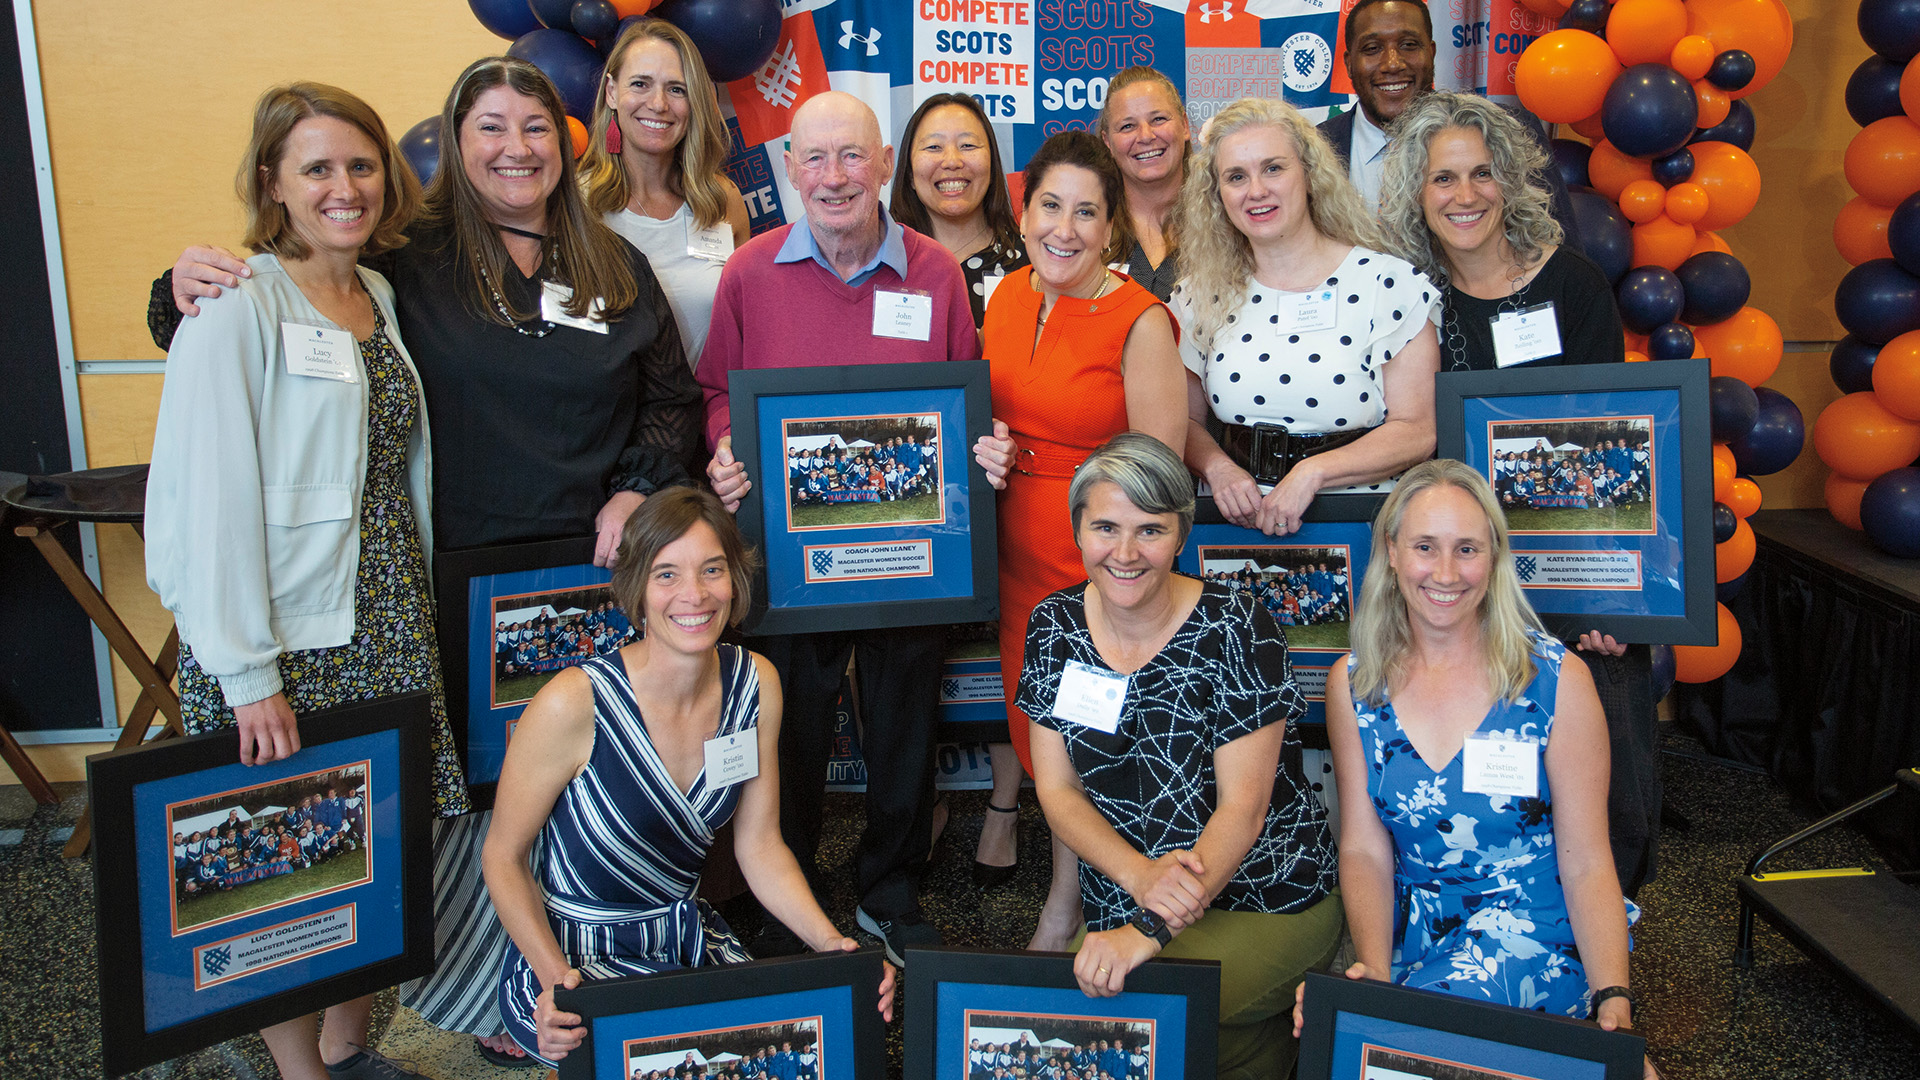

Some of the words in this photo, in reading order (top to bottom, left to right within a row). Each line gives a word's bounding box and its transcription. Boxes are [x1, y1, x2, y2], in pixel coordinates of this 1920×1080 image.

[920, 0, 1029, 25] COMPETE
[1038, 0, 1154, 31] SCOTS
[936, 30, 1012, 55] SCOTS
[1040, 34, 1155, 71] SCOTS
[1188, 54, 1280, 74] COMPETE
[1314, 38, 1330, 75] COLLEGE
[920, 60, 1028, 86] COMPETE
[1042, 77, 1110, 110] SCO
[1186, 78, 1280, 98] COMPETE
[971, 94, 1016, 117] OTS
[896, 312, 912, 320] John
[1518, 333, 1535, 342] Kate
[313, 348, 332, 358] Lucy
[1486, 762, 1518, 772] Kristine
[238, 940, 285, 959] MACALESTER
[286, 930, 319, 945] WOMEN'S
[320, 922, 348, 934] SOCCER
[250, 932, 274, 944] LUCY
[276, 918, 322, 937] GOLDSTEIN
[323, 914, 335, 923] #11
[245, 958, 262, 967] 1998
[263, 948, 299, 962] NATIONAL
[300, 934, 342, 951] CHAMPIONS
